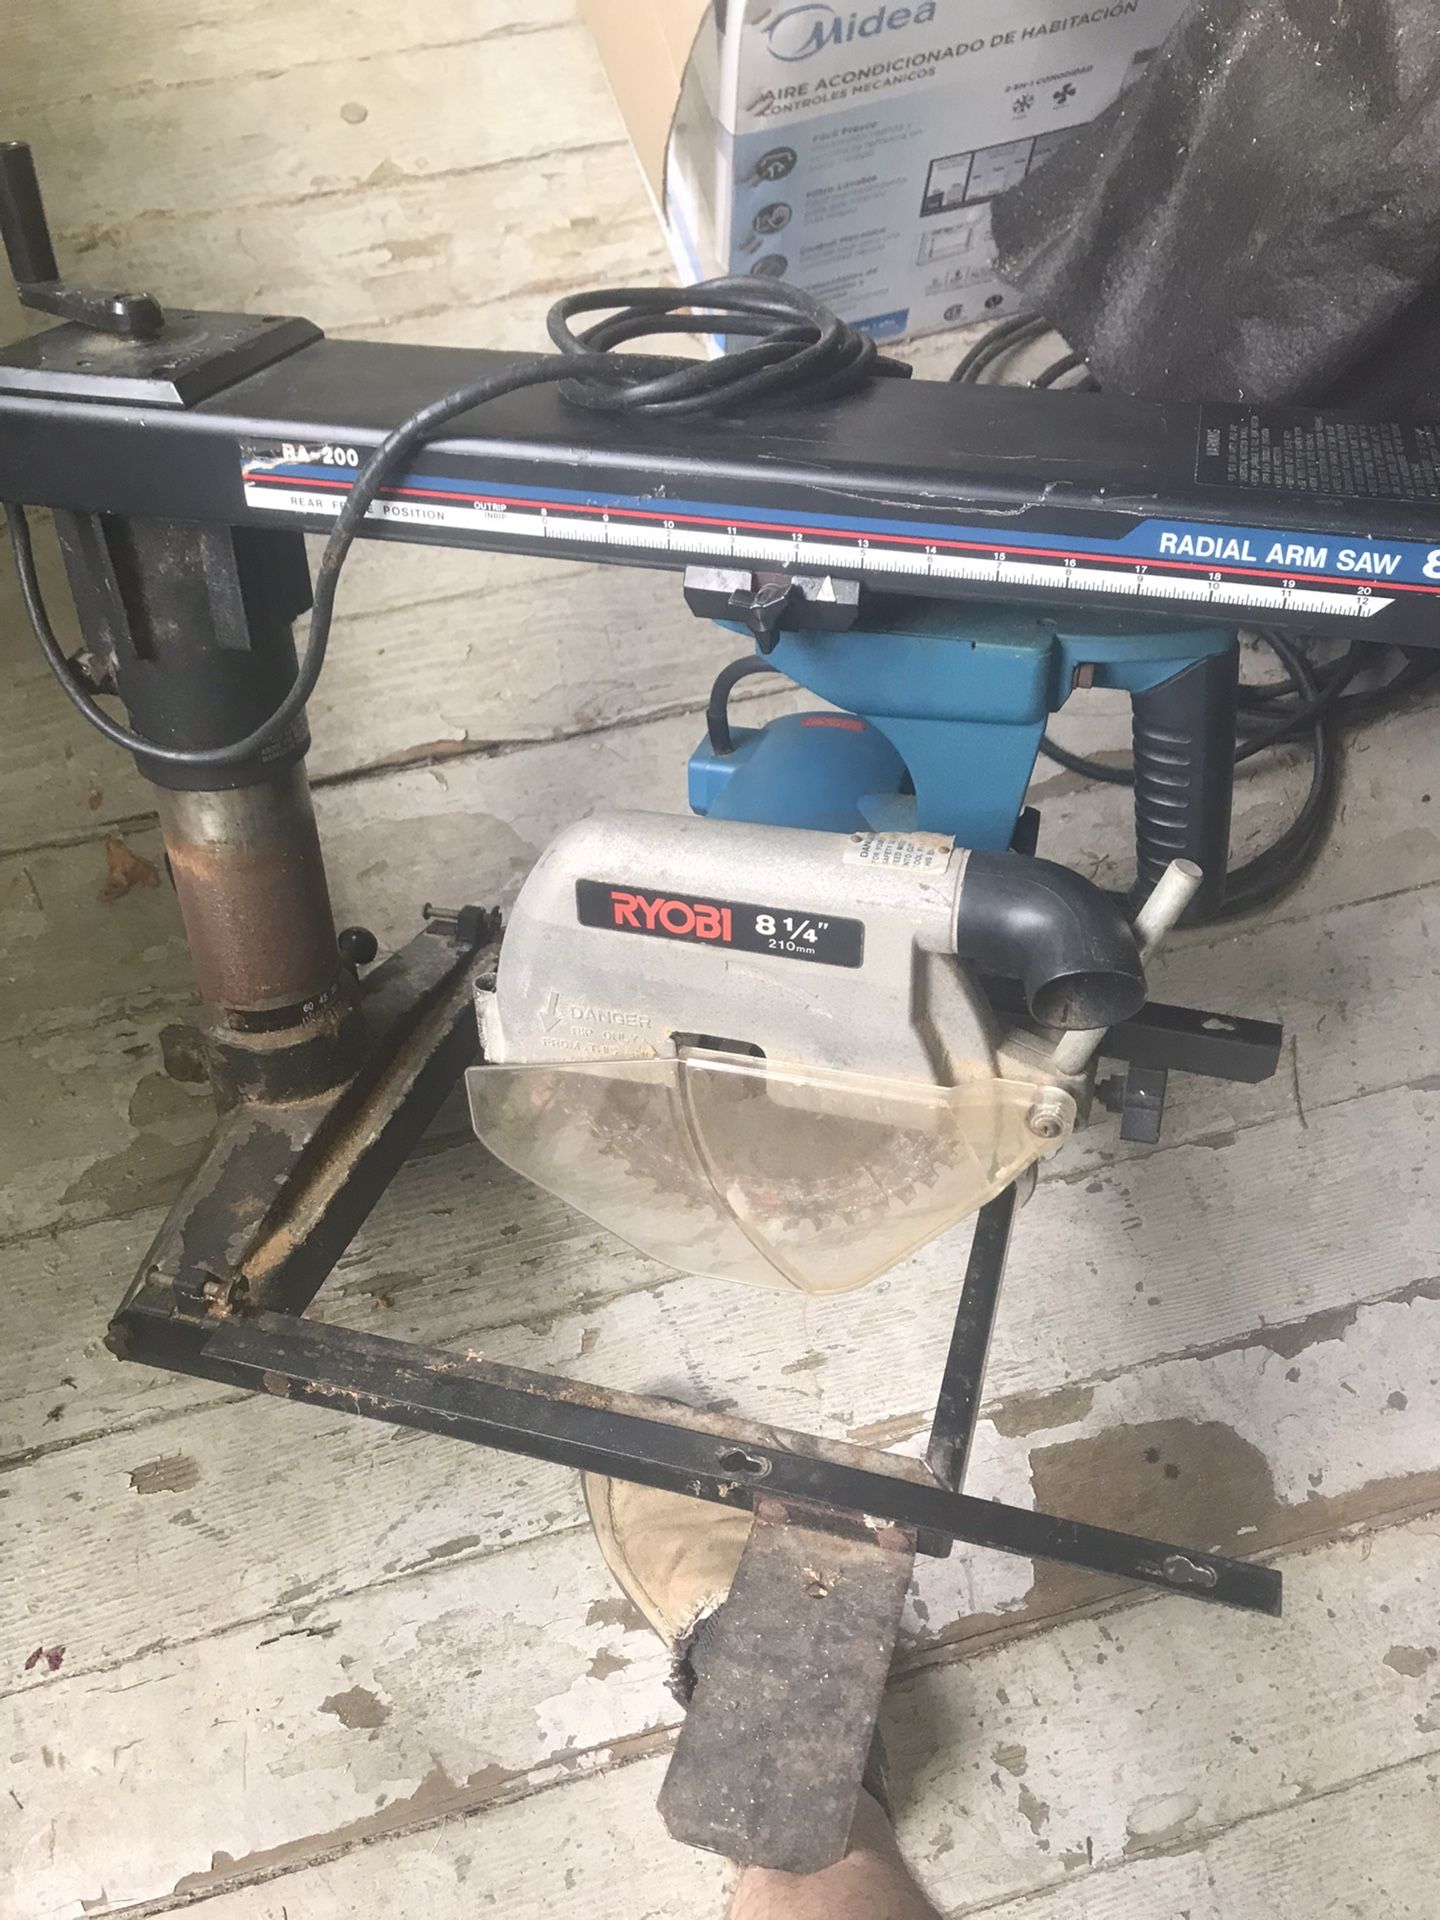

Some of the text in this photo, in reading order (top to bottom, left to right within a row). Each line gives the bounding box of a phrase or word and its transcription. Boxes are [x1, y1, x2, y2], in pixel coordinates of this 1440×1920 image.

[790, 0, 937, 56] Midea
[762, 0, 1139, 102] AIRE ACONDICIONADO DE HABITACIÓN
[282, 443, 360, 468] RA-200
[290, 496, 324, 509] REAR
[383, 504, 445, 520] POSITION
[473, 501, 1372, 596] OUTRIP 8 9 10 11 12 13 14 15 16 17 18 19 20
[1159, 532, 1257, 562] RADIAL
[1265, 542, 1328, 568] ARM
[1336, 549, 1402, 575] SAW
[1065, 568, 1072, 576] 8
[1208, 582, 1220, 590] 10
[1281, 589, 1292, 597] 11
[1356, 596, 1369, 605] 12
[611, 892, 732, 942] RYOBI
[755, 914, 776, 936] 8
[768, 938, 815, 955] 210mm
[303, 1002, 314, 1013] 60
[569, 1005, 652, 1029] DANGER
